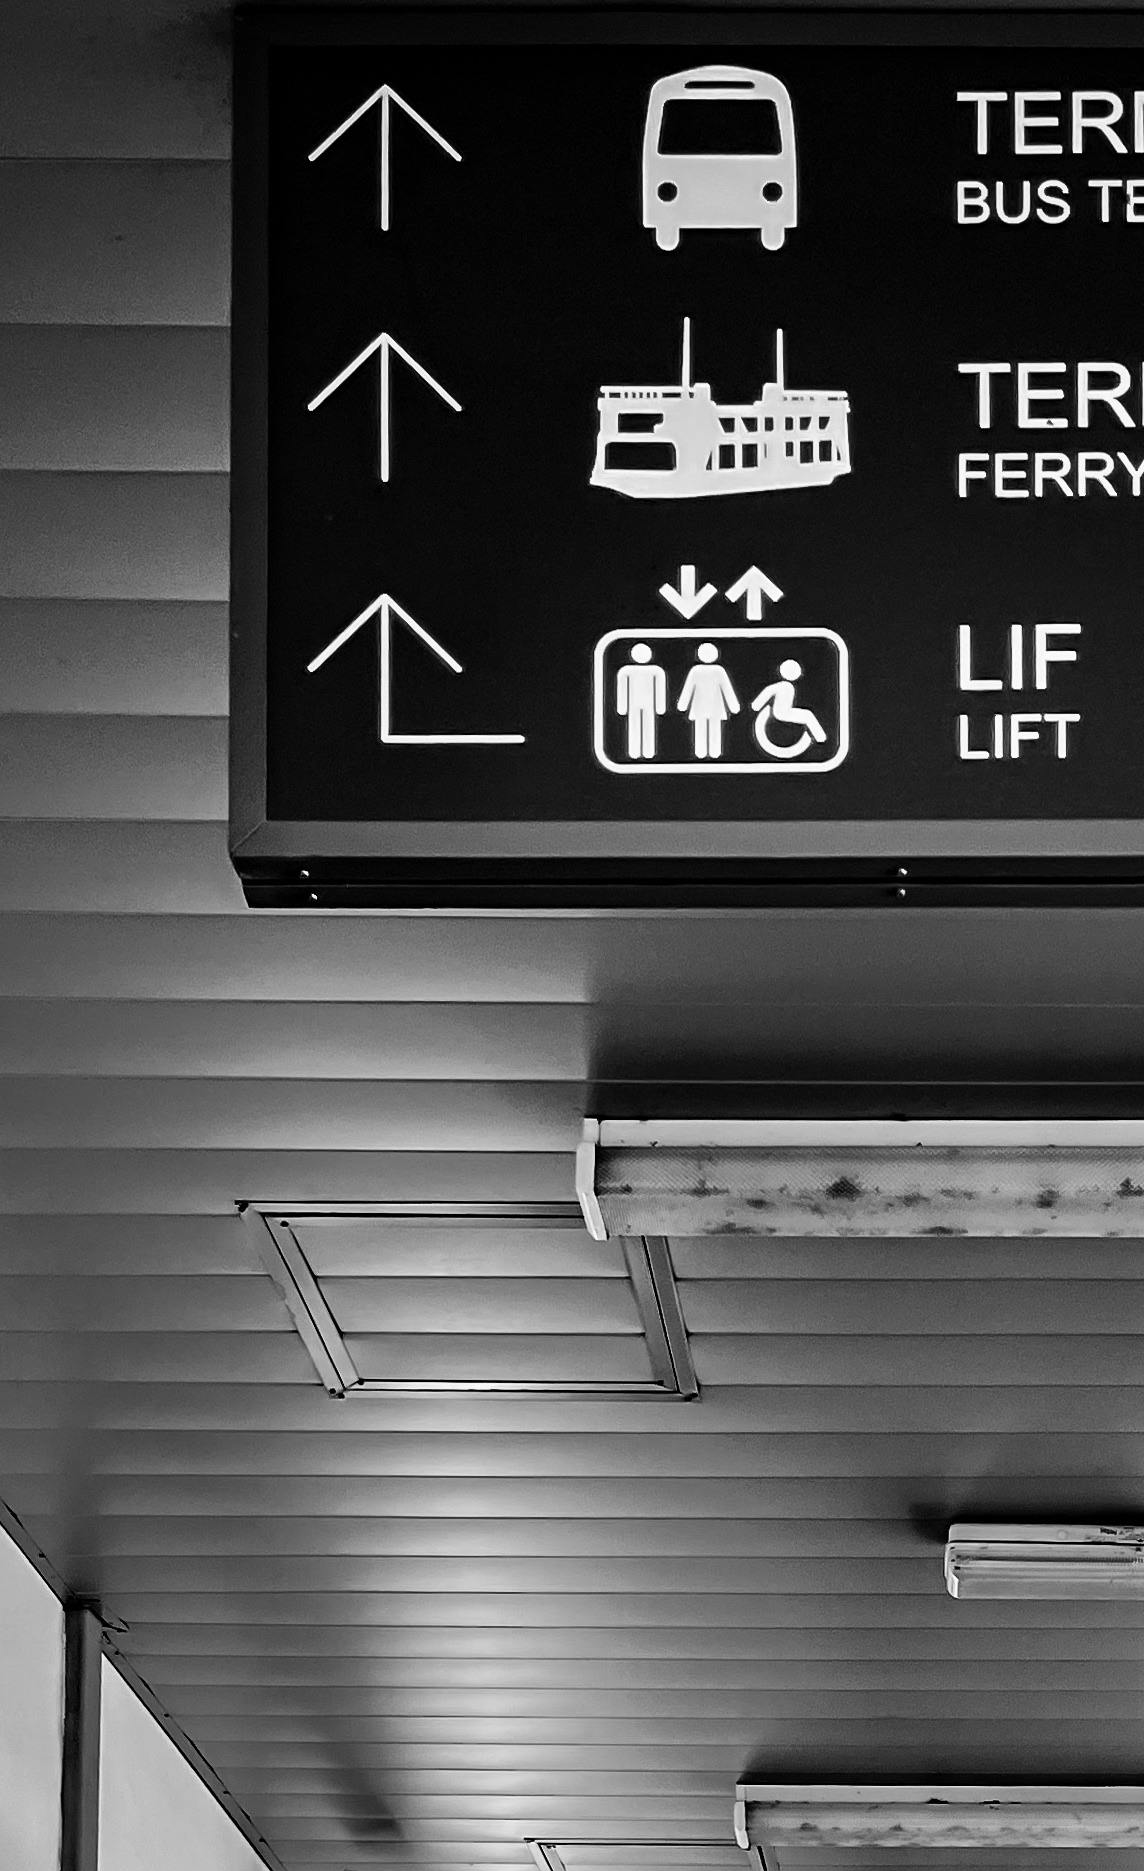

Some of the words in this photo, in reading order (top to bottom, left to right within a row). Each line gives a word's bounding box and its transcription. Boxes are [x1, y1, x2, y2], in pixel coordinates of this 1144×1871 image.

[956, 180, 1071, 225] BUS
[957, 623, 1082, 691] LIF
[957, 713, 1081, 760] LIFT
